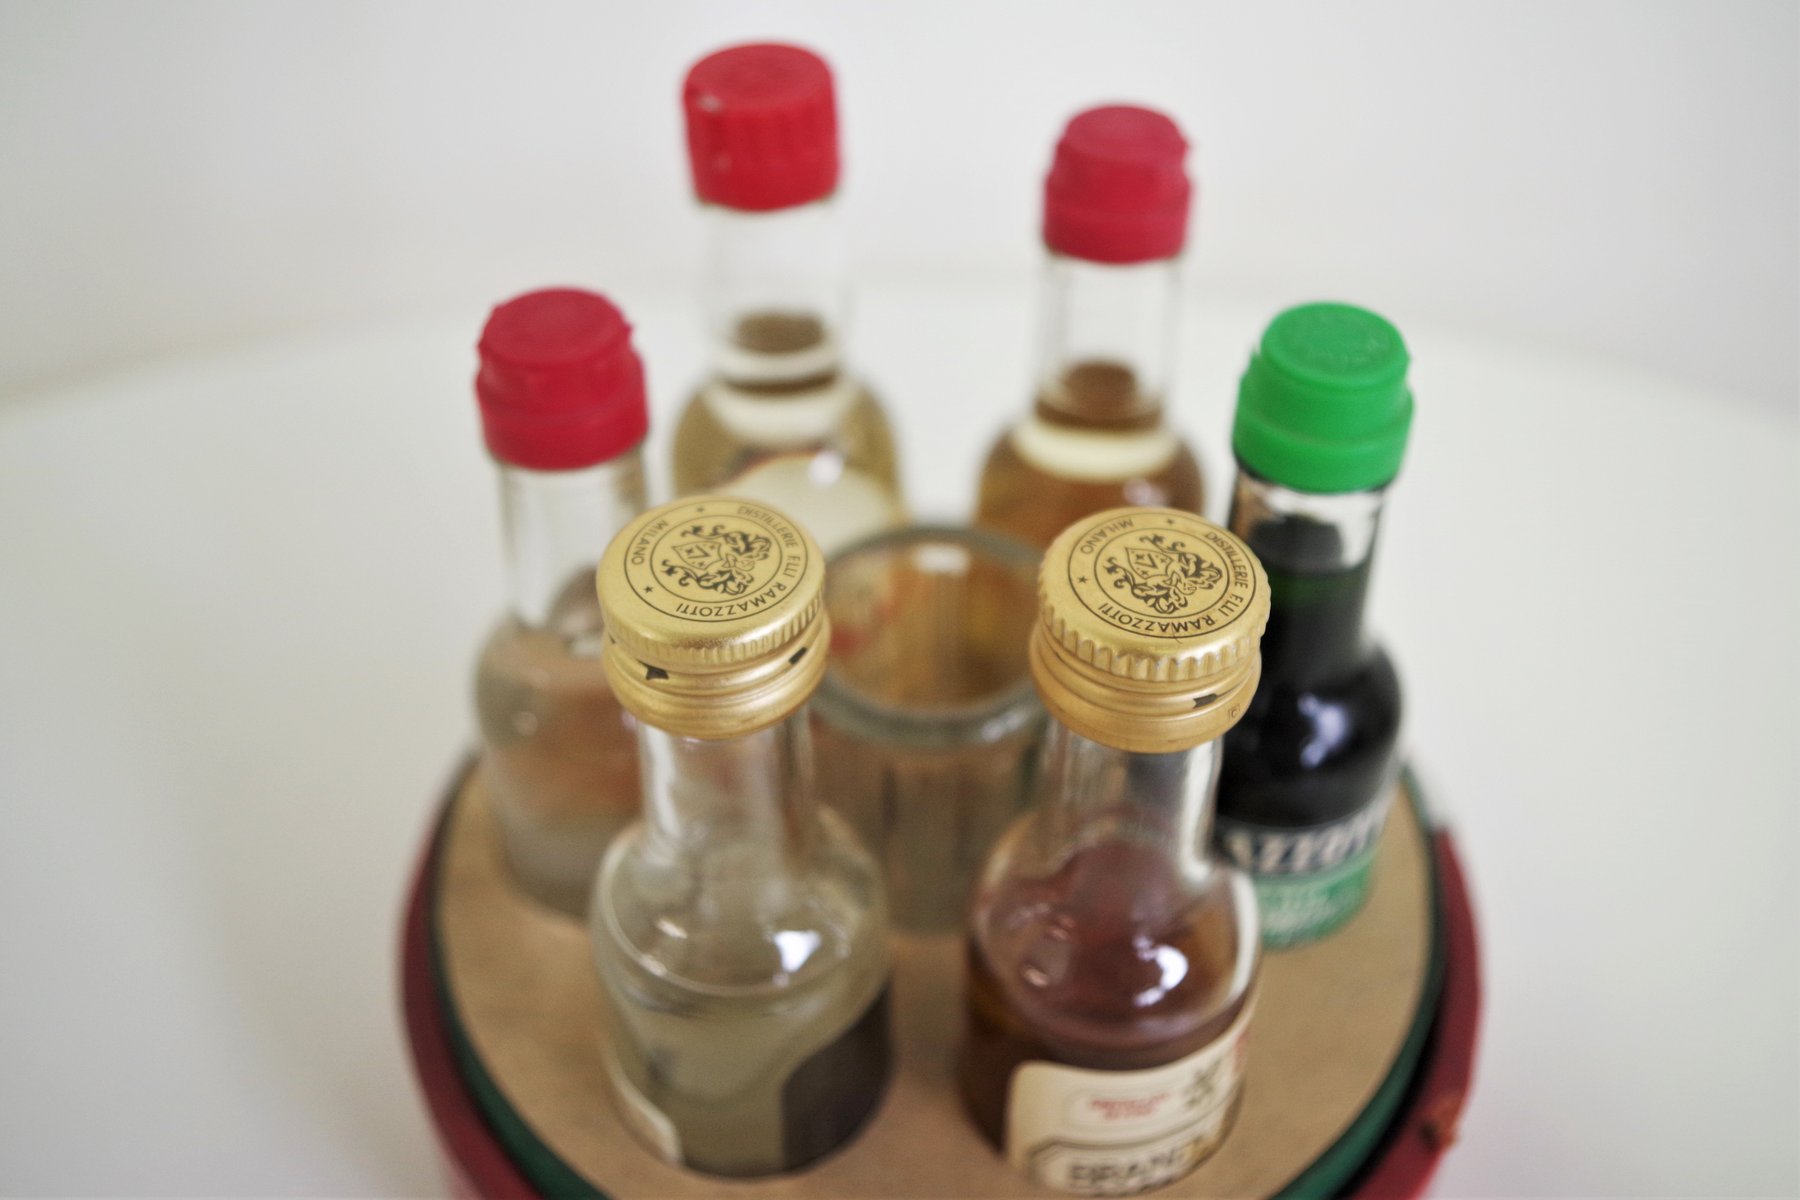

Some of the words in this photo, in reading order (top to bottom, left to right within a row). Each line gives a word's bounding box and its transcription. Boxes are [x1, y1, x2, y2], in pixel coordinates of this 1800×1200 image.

[631, 519, 669, 566] MILANO
[737, 505, 799, 549] DISTILLERIE
[1080, 518, 1134, 555] MILANO
[1203, 531, 1249, 589] DISTILLERIE
[675, 581, 788, 617] RAMAZZOTTI
[1097, 601, 1216, 633] RAMAZZOTTI
